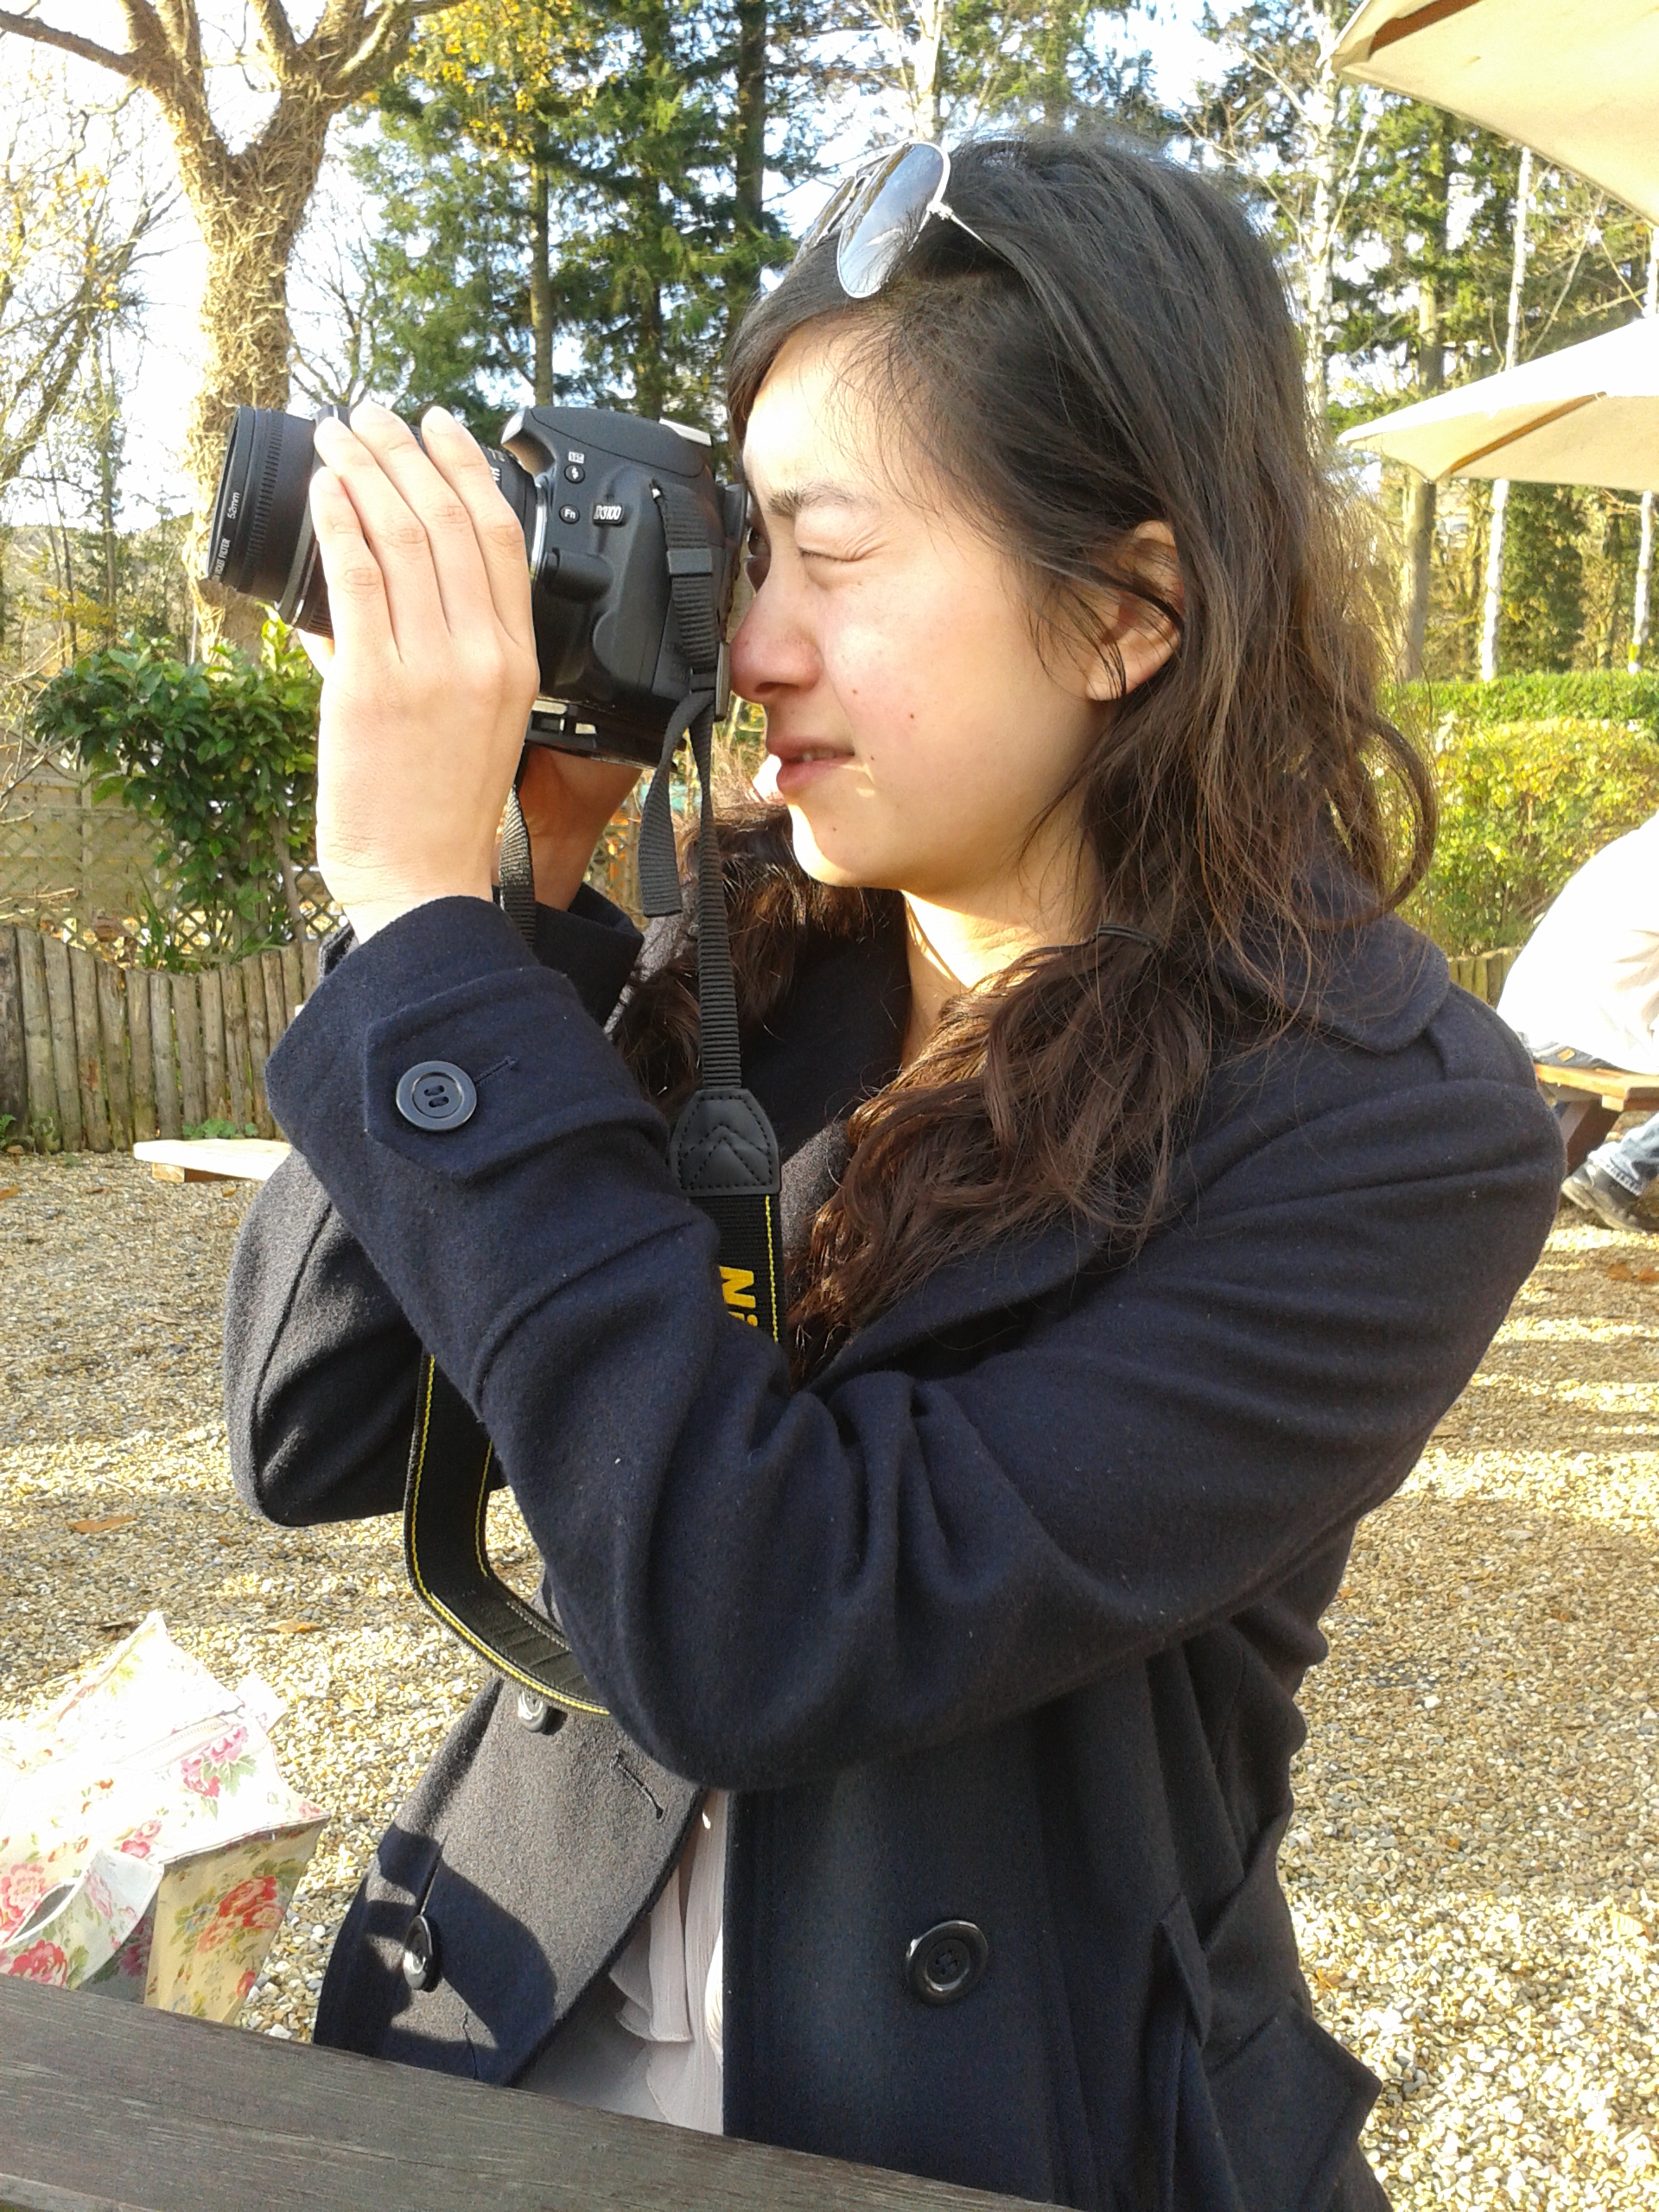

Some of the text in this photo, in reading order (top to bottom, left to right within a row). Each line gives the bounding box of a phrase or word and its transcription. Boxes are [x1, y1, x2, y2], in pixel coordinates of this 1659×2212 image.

[227, 492, 241, 519] 52mm
[594, 505, 622, 520] D3100
[564, 508, 576, 519] Fn
